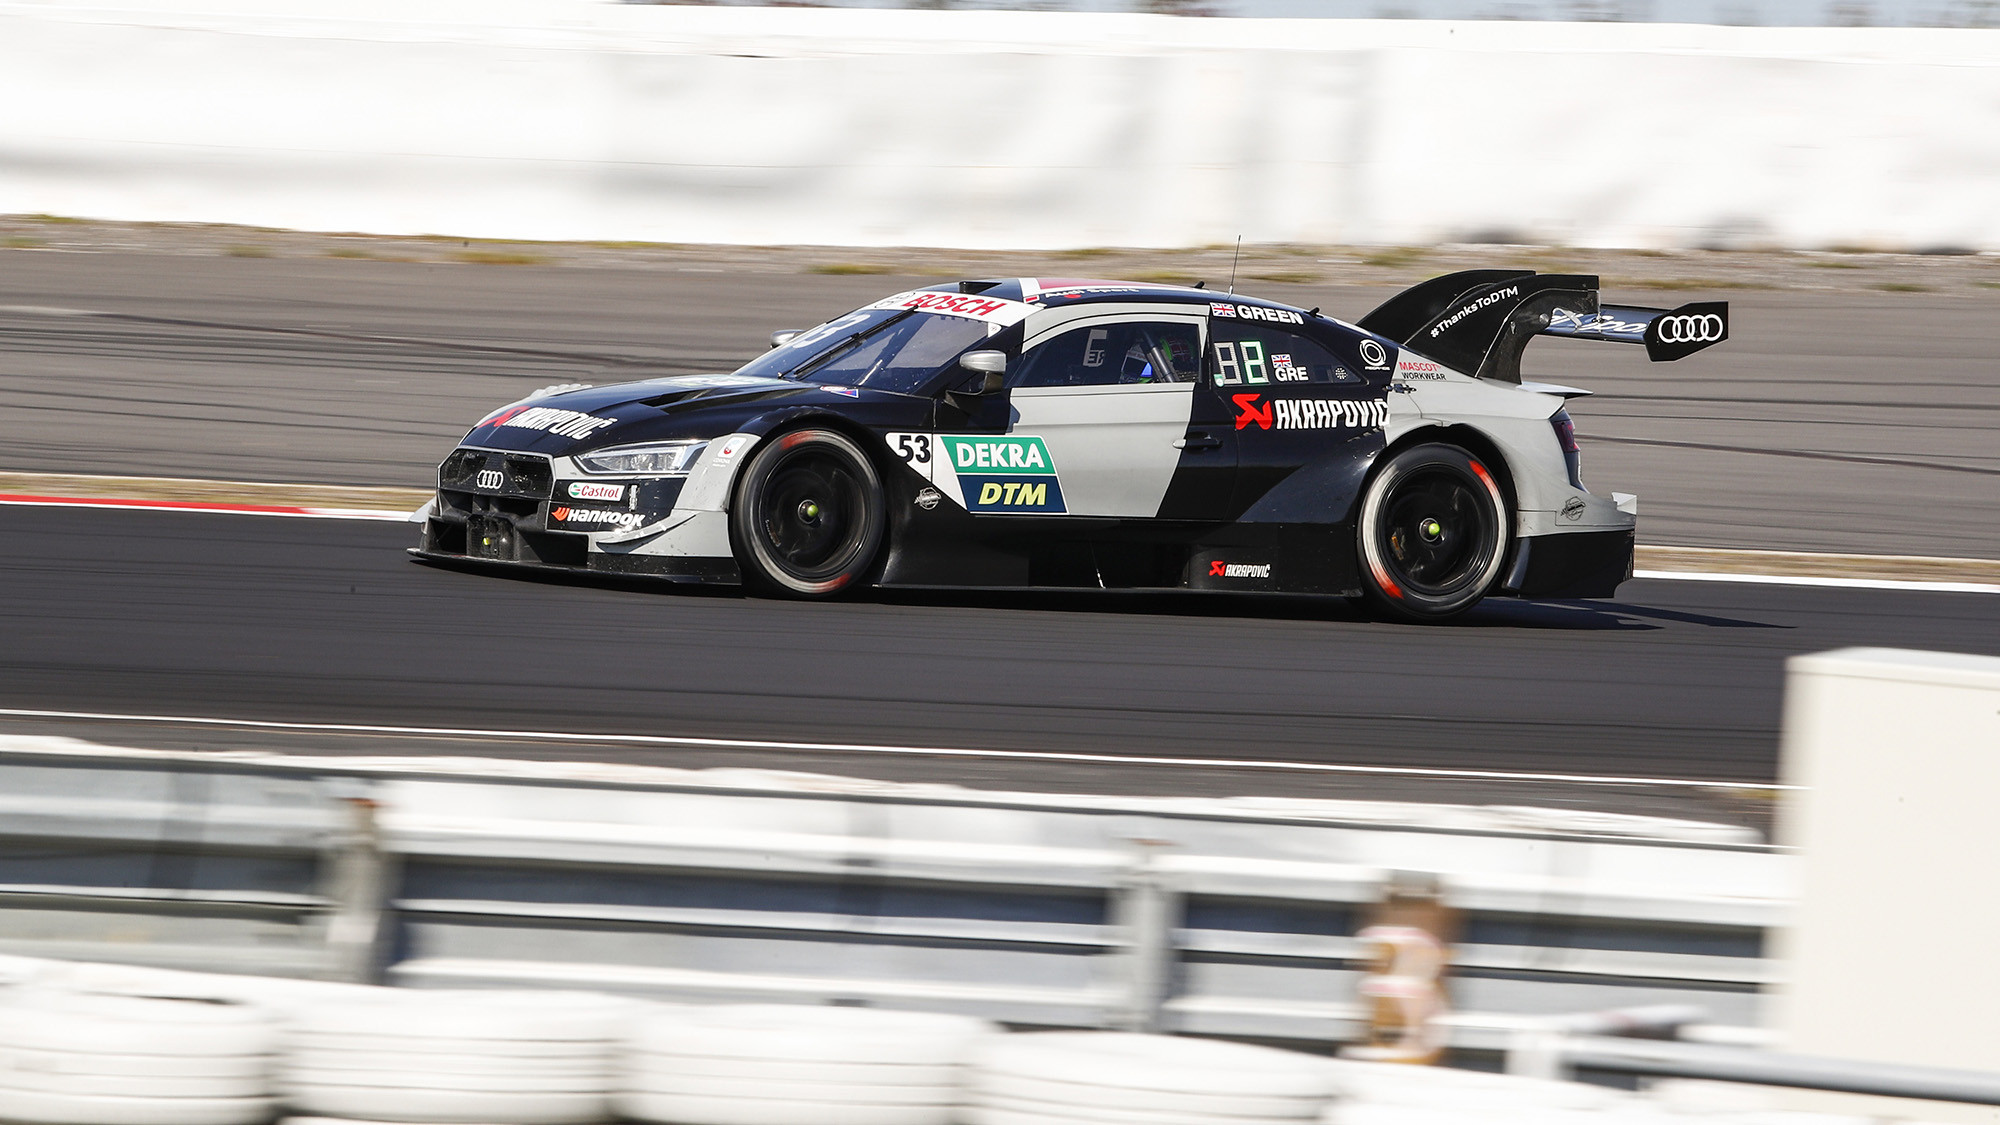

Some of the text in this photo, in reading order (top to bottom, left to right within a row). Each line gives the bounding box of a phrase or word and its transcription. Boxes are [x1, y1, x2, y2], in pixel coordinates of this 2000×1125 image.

[902, 293, 1007, 316] BOSCH
[1237, 305, 1304, 325] GREEN
[1430, 285, 1519, 338] #ThanksToDTM
[1275, 367, 1309, 382] GRE
[1398, 362, 1438, 372] MASCOT
[1401, 372, 1447, 381] WORKWEAR
[899, 435, 931, 463] 53
[956, 443, 1045, 468] DEKRA
[581, 485, 620, 499] Castrol
[978, 482, 1047, 506] DTM
